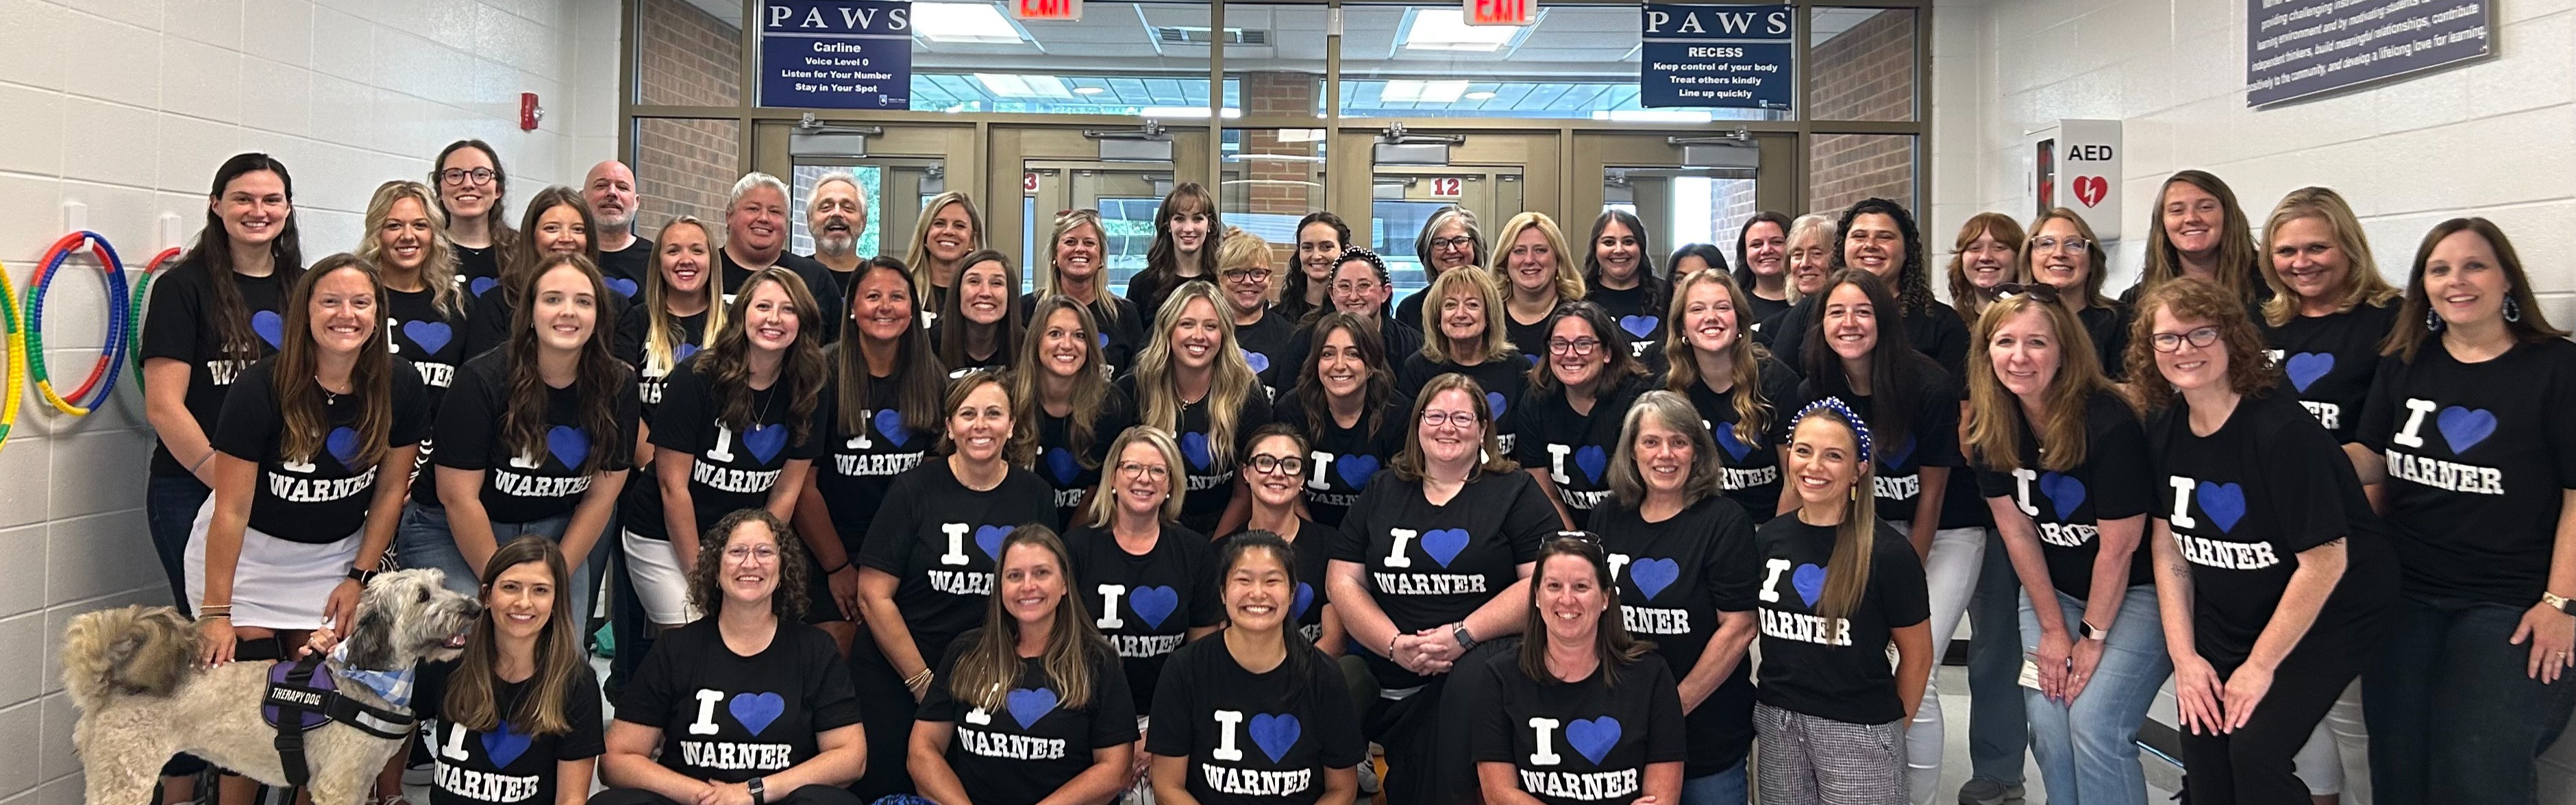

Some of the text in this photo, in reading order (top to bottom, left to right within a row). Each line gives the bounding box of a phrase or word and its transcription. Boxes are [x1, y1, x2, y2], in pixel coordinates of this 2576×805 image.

[769, 6, 908, 30] PAWS
[1646, 12, 1787, 34] PAWS
[2278, 24, 2323, 44] environment
[2323, 19, 2338, 32] and
[2338, 18, 2348, 31] by
[2349, 7, 2386, 26] motivating
[2289, 3, 2333, 21] challenging
[2315, 40, 2334, 55] build
[2335, 29, 2375, 50] meaningful
[2375, 16, 2431, 36] relationships,
[2432, 3, 2479, 24] contribute
[805, 57, 832, 66] Voice
[834, 58, 860, 66] Level
[813, 42, 861, 53] Carline
[1688, 47, 1744, 58] RECESS
[2274, 75, 2281, 86] to
[2281, 73, 2291, 84] the
[2327, 58, 2342, 72] and
[2343, 53, 2371, 68] develop
[2372, 51, 2379, 61] a
[2379, 43, 2412, 59] lifelong
[2412, 39, 2433, 51] love
[2433, 34, 2448, 47] for
[2448, 25, 2488, 44] learning.
[782, 69, 892, 80] Listen for Your Number
[1653, 62, 1778, 73] Keep control of your body
[1670, 75, 1762, 86] Treat others kindly
[795, 83, 878, 94] Stay in Your Spot
[1679, 89, 1753, 99] Line up quickly
[2068, 145, 2113, 161] AED
[1434, 178, 1459, 195] 12
[706, 417, 734, 462] I
[2393, 397, 2437, 448] I
[1307, 450, 1335, 491] I
[1547, 443, 1571, 485] I
[1718, 465, 1777, 491] RNER
[2385, 448, 2505, 495] WARNER
[1873, 473, 1920, 501] RNE
[2011, 467, 2040, 517] I
[2170, 475, 2196, 529] I
[941, 522, 970, 566] I
[1384, 527, 1418, 568] I
[928, 569, 995, 596] WARN
[1374, 571, 1487, 595] WARNER
[1759, 558, 1792, 604] I
[1096, 583, 1126, 629] I
[1620, 604, 1691, 634] RNER
[271, 687, 321, 706] THERAPY DOG
[689, 688, 725, 736] I
[441, 722, 469, 762] I
[958, 726, 1067, 760] WARNER
[1213, 709, 1243, 762] I
[1528, 717, 1561, 766] I
[680, 740, 792, 770] WARNER
[433, 757, 540, 803] WARNER
[1202, 763, 1311, 797] WARNER
[1520, 767, 1639, 801] WARNER
